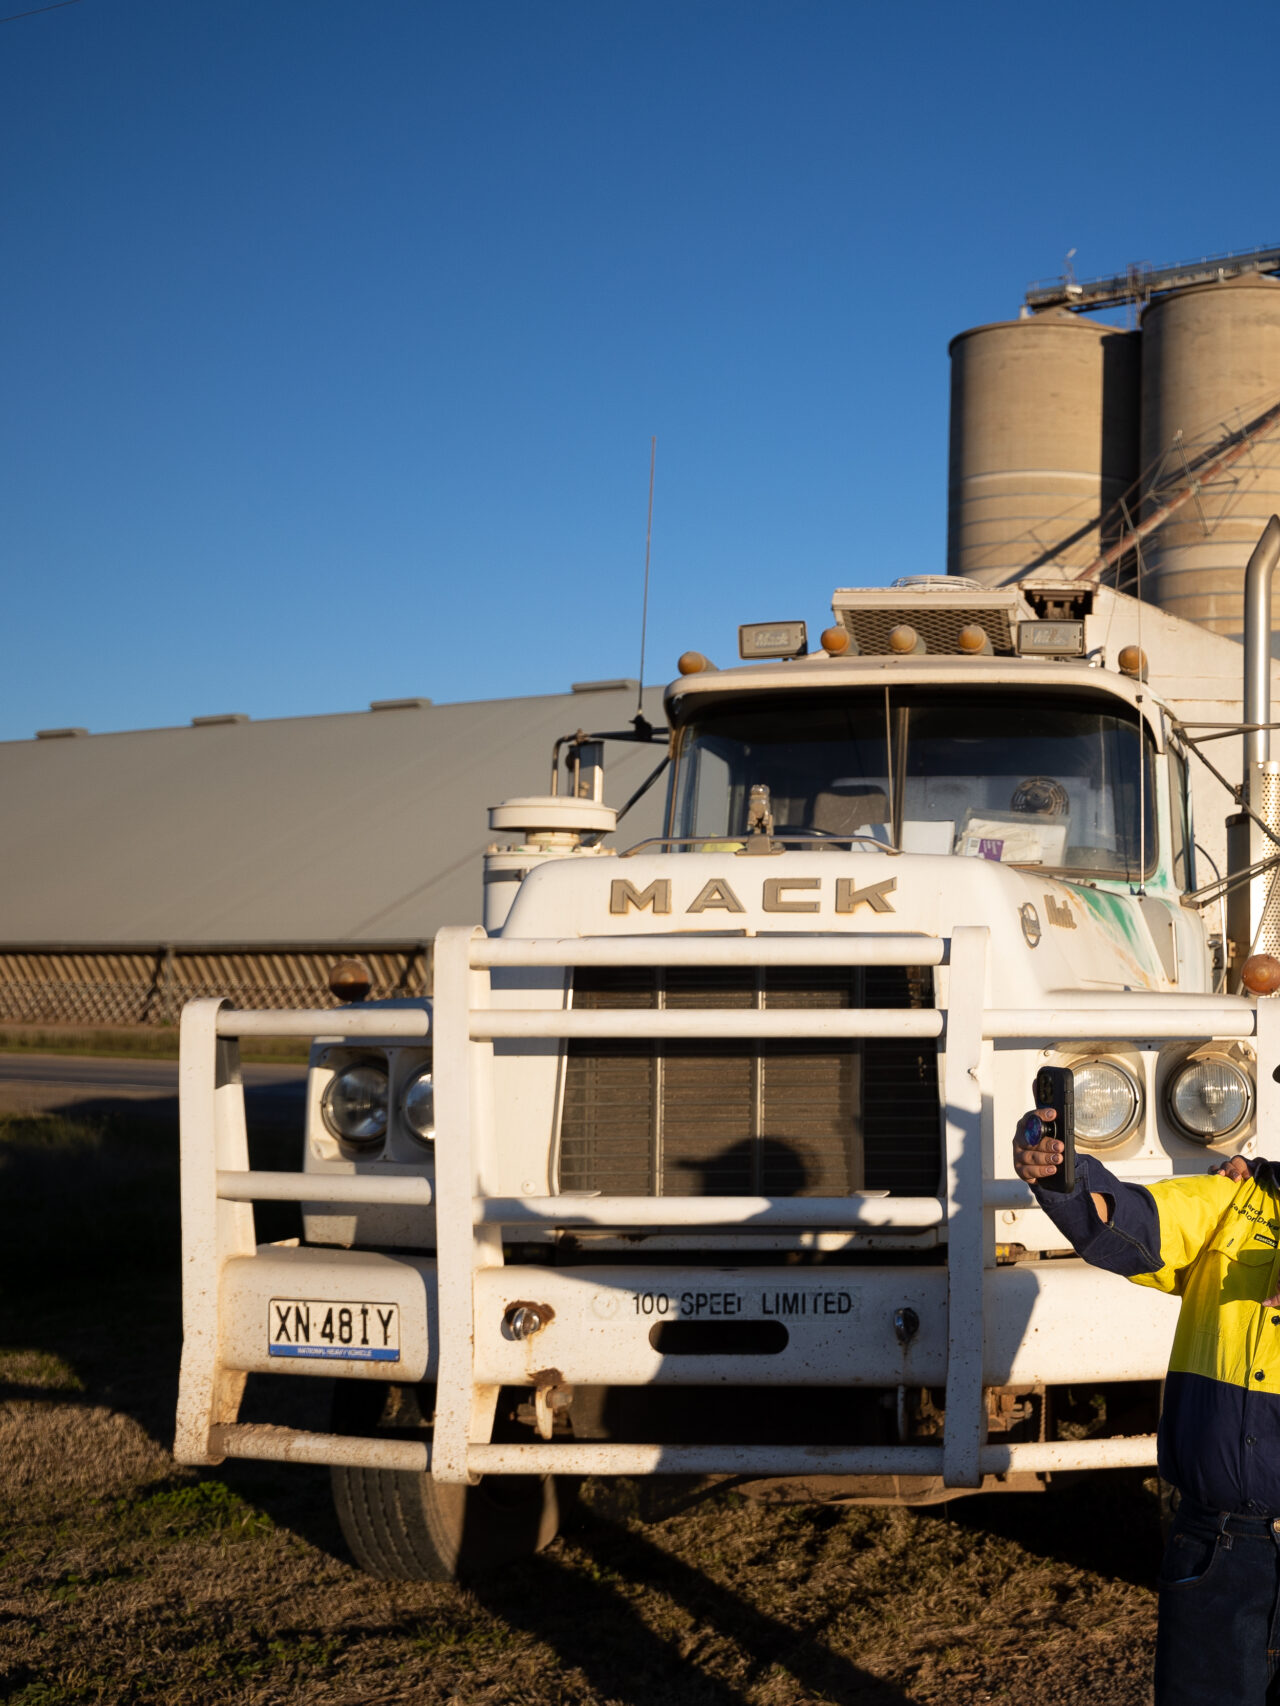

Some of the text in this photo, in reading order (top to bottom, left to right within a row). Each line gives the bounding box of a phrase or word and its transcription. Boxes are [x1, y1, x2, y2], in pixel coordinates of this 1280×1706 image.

[609, 876, 898, 914] MACK
[632, 1292, 669, 1315] 100
[761, 1292, 852, 1315] LIMITED
